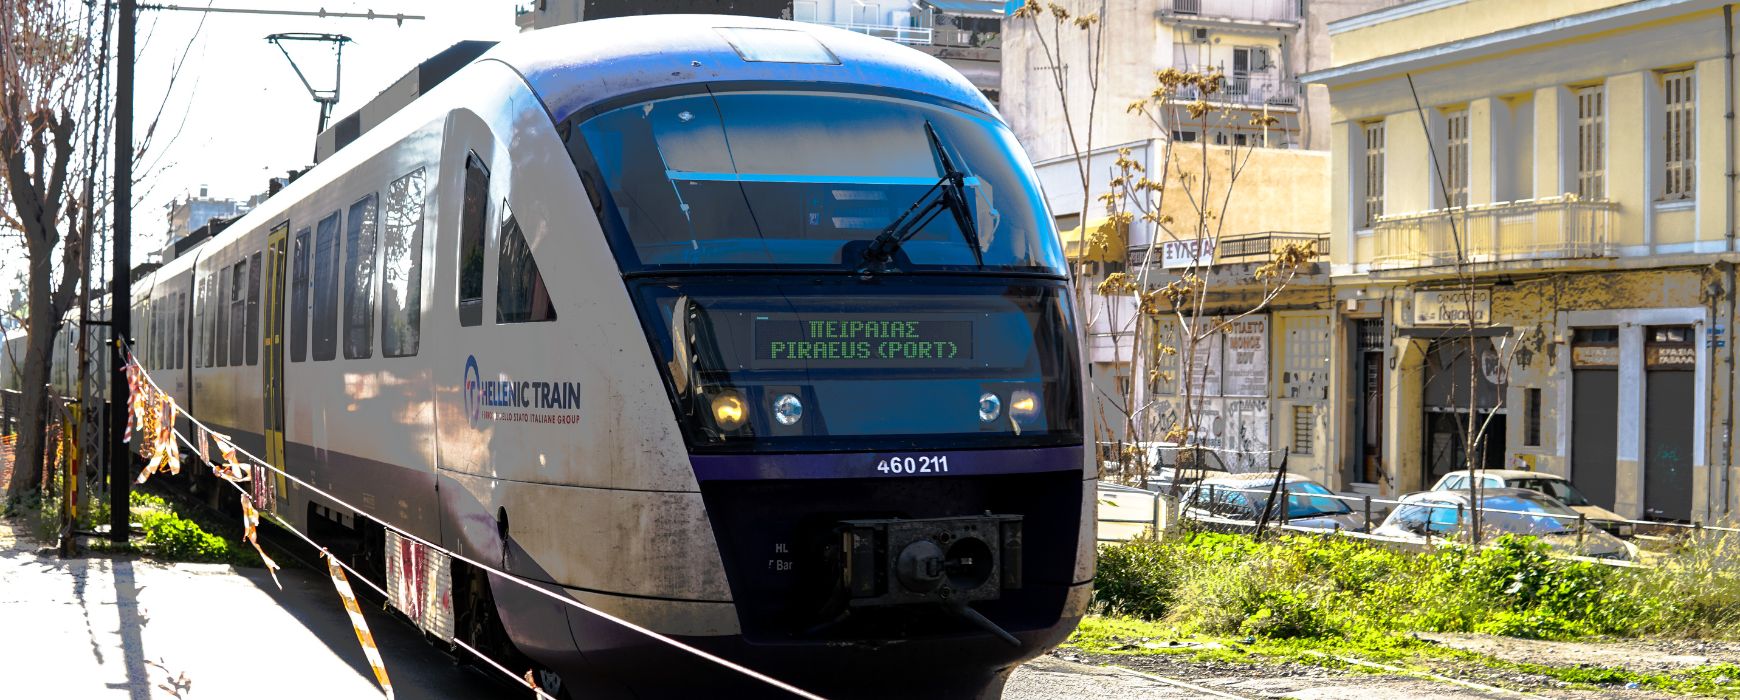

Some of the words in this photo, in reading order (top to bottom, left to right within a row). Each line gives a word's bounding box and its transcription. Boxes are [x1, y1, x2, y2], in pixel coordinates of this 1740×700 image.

[809, 321, 919, 338] ΠΕΙΡΑΙΑΣ
[771, 342, 871, 359] PIRAEUS
[878, 342, 958, 359] (PORT)
[481, 380, 530, 408] HELLENIC
[532, 381, 581, 410] TRAIN
[557, 415, 580, 425] GROUP
[775, 543, 789, 553] HL
[776, 560, 793, 571] Bar
